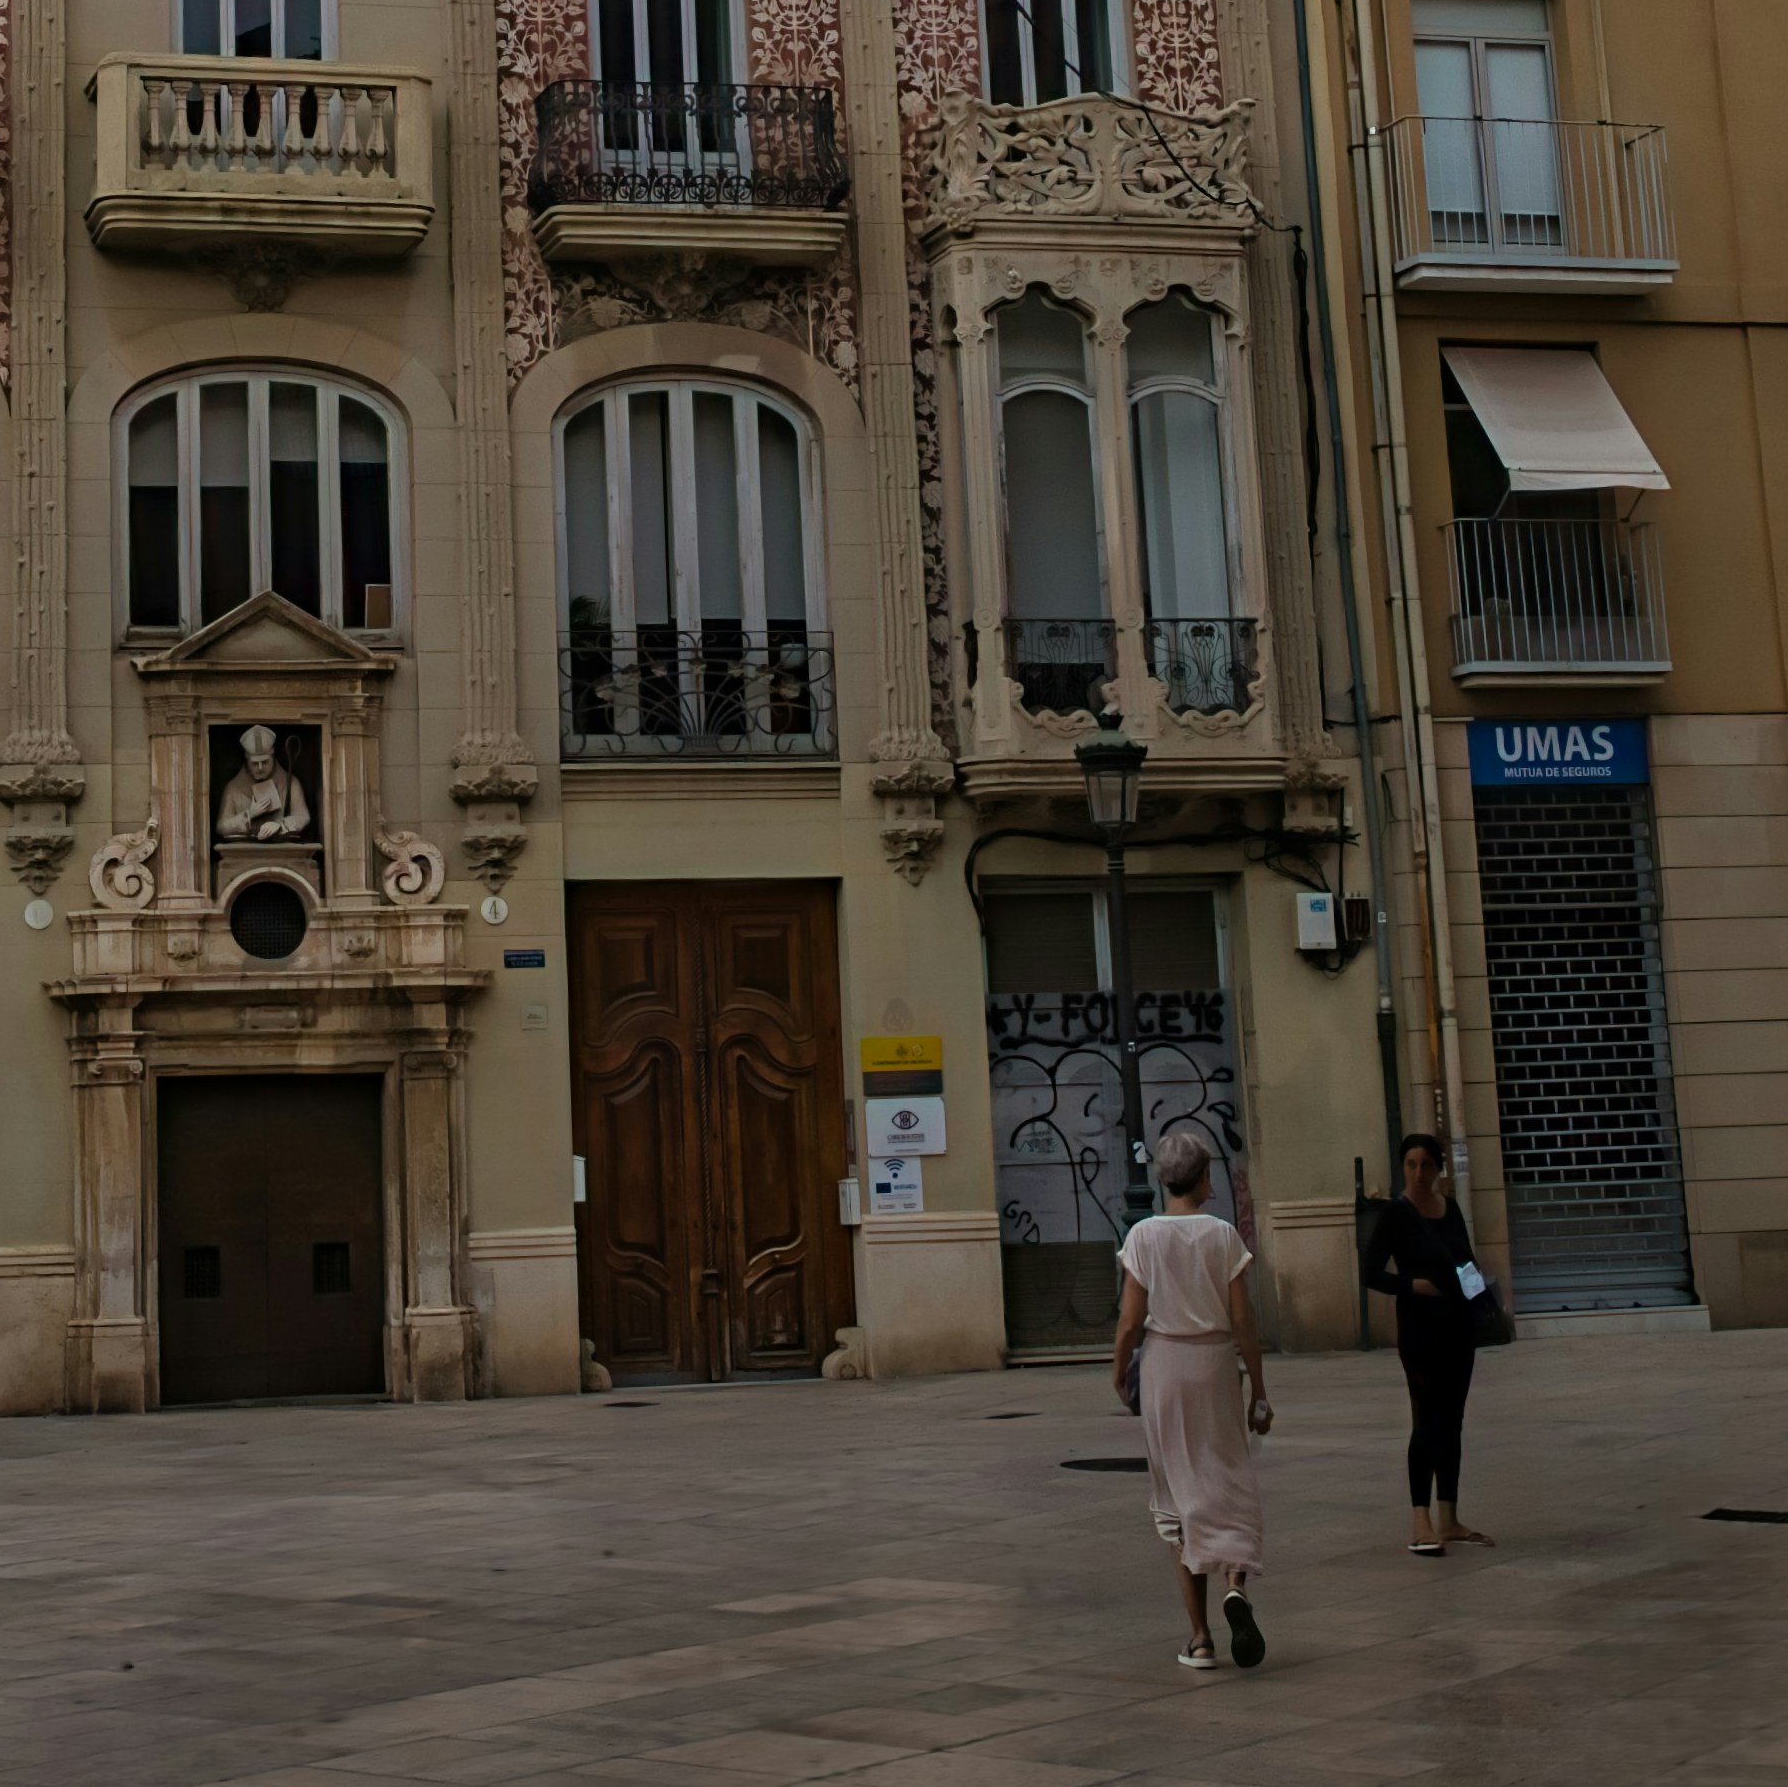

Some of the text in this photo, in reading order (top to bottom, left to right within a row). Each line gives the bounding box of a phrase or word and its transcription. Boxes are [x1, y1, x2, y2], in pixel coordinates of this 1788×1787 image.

[1495, 725, 1615, 763] UMAS
[1504, 766, 1612, 778] MUTUA DE SEGUROS
[488, 900, 500, 920] 4
